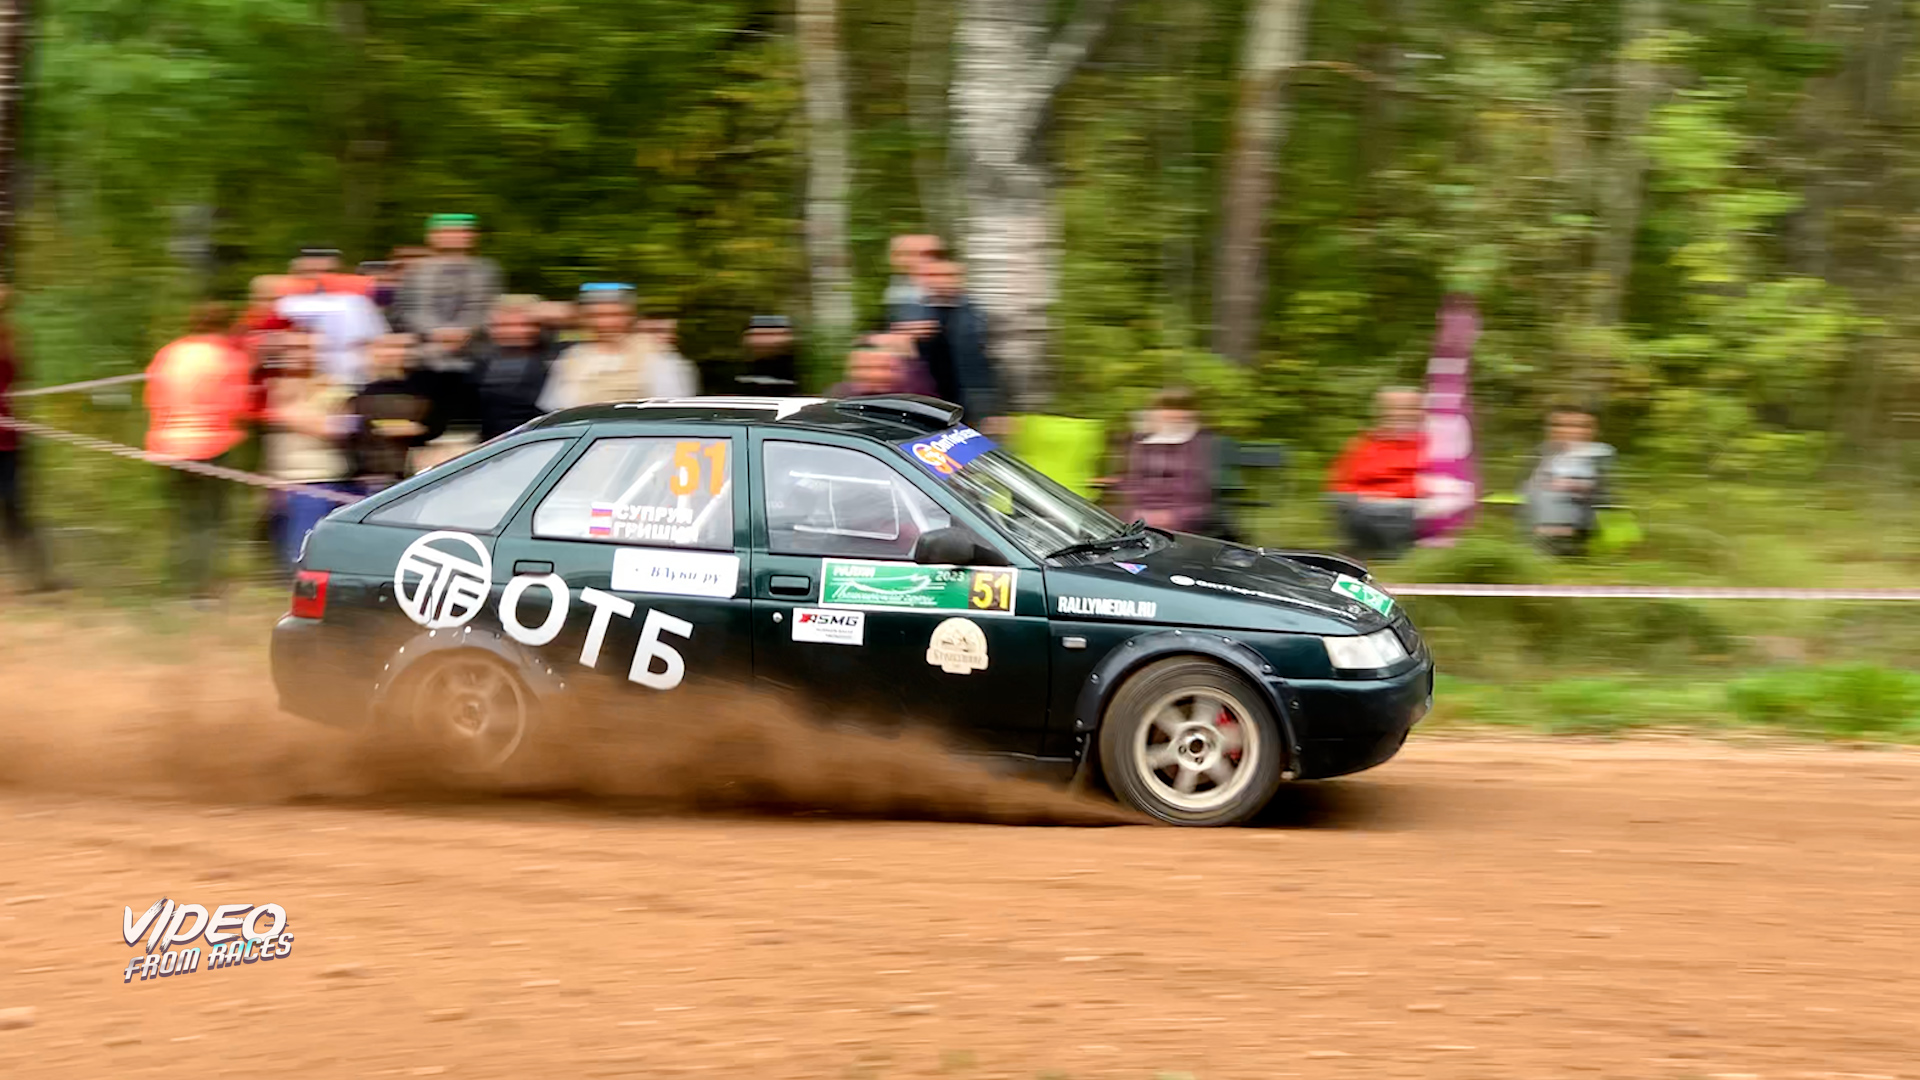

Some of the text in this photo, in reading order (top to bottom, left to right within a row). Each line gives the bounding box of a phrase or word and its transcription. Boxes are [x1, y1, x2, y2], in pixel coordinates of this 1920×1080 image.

[669, 441, 726, 497] 51
[613, 521, 699, 543] ГРИШИ
[935, 571, 965, 582] 2023
[971, 571, 1012, 609] 51
[1057, 596, 1157, 618] RALLYMEDIA.RU
[499, 572, 694, 690] ОТБ
